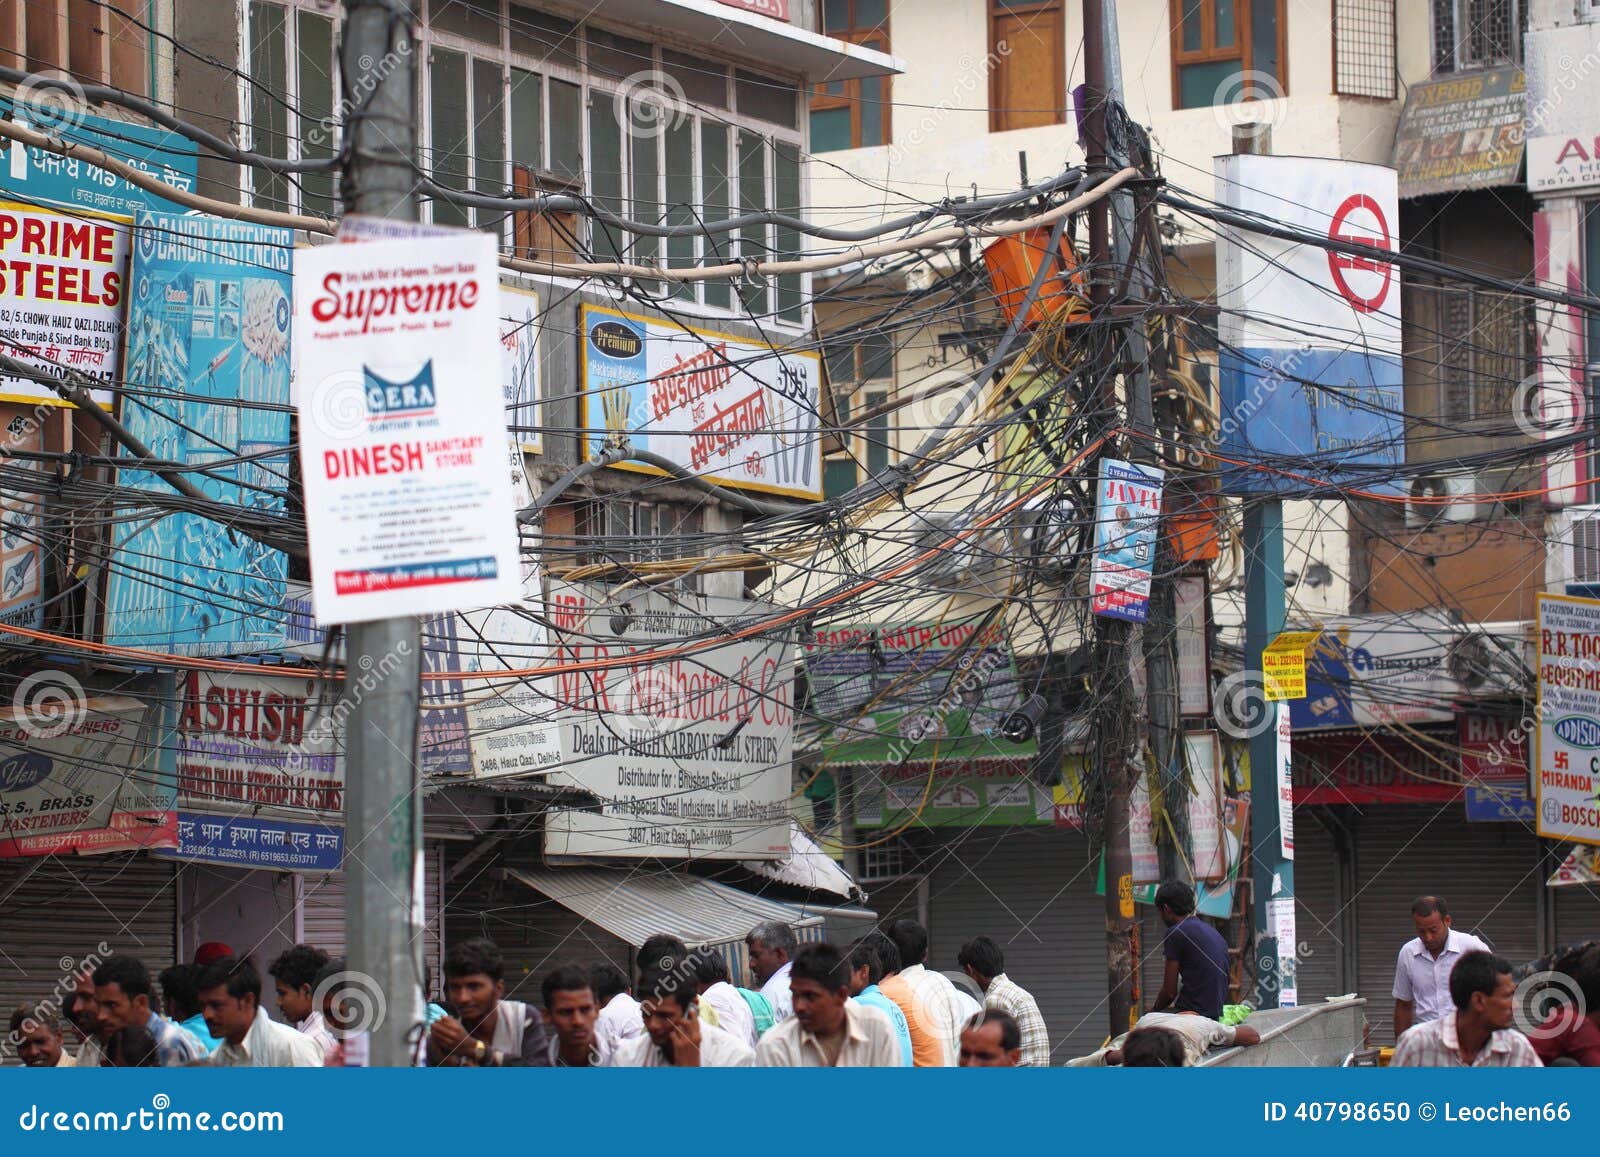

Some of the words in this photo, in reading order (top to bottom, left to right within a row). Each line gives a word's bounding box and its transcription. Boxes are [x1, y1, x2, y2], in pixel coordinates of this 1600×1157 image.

[0, 215, 114, 263] PRIME
[311, 272, 480, 335] Supreme
[52, 315, 71, 329] HAUZ
[22, 329, 47, 344] Punjab
[49, 333, 54, 343] &
[56, 332, 72, 345] Sind
[74, 335, 91, 348] Bank
[597, 327, 636, 354] Premium
[425, 435, 483, 453] SANITARY
[324, 442, 424, 480] DINESH
[435, 453, 473, 469] STORE
[628, 647, 730, 723] Malhotra
[760, 658, 791, 727] Co.
[181, 670, 307, 745] ASHISH
[573, 725, 604, 755] Deals
[745, 736, 778, 765] STRIPS
[501, 757, 518, 769] Hauz
[520, 753, 537, 766] Qazi,
[538, 751, 561, 764] Delhi-6
[618, 766, 660, 789] Distributor
[662, 767, 672, 788] for
[678, 769, 709, 790] Bhushan
[1542, 770, 1592, 793] MIRANDA
[39, 794, 95, 811] BRASS
[661, 797, 679, 817] Steel
[0, 809, 90, 833] FASTENERS
[200, 823, 224, 841] भान
[260, 829, 286, 848] लाल
[289, 831, 311, 853] एन्ड
[315, 833, 340, 850] सन्ज
[651, 828, 670, 844] Hauz
